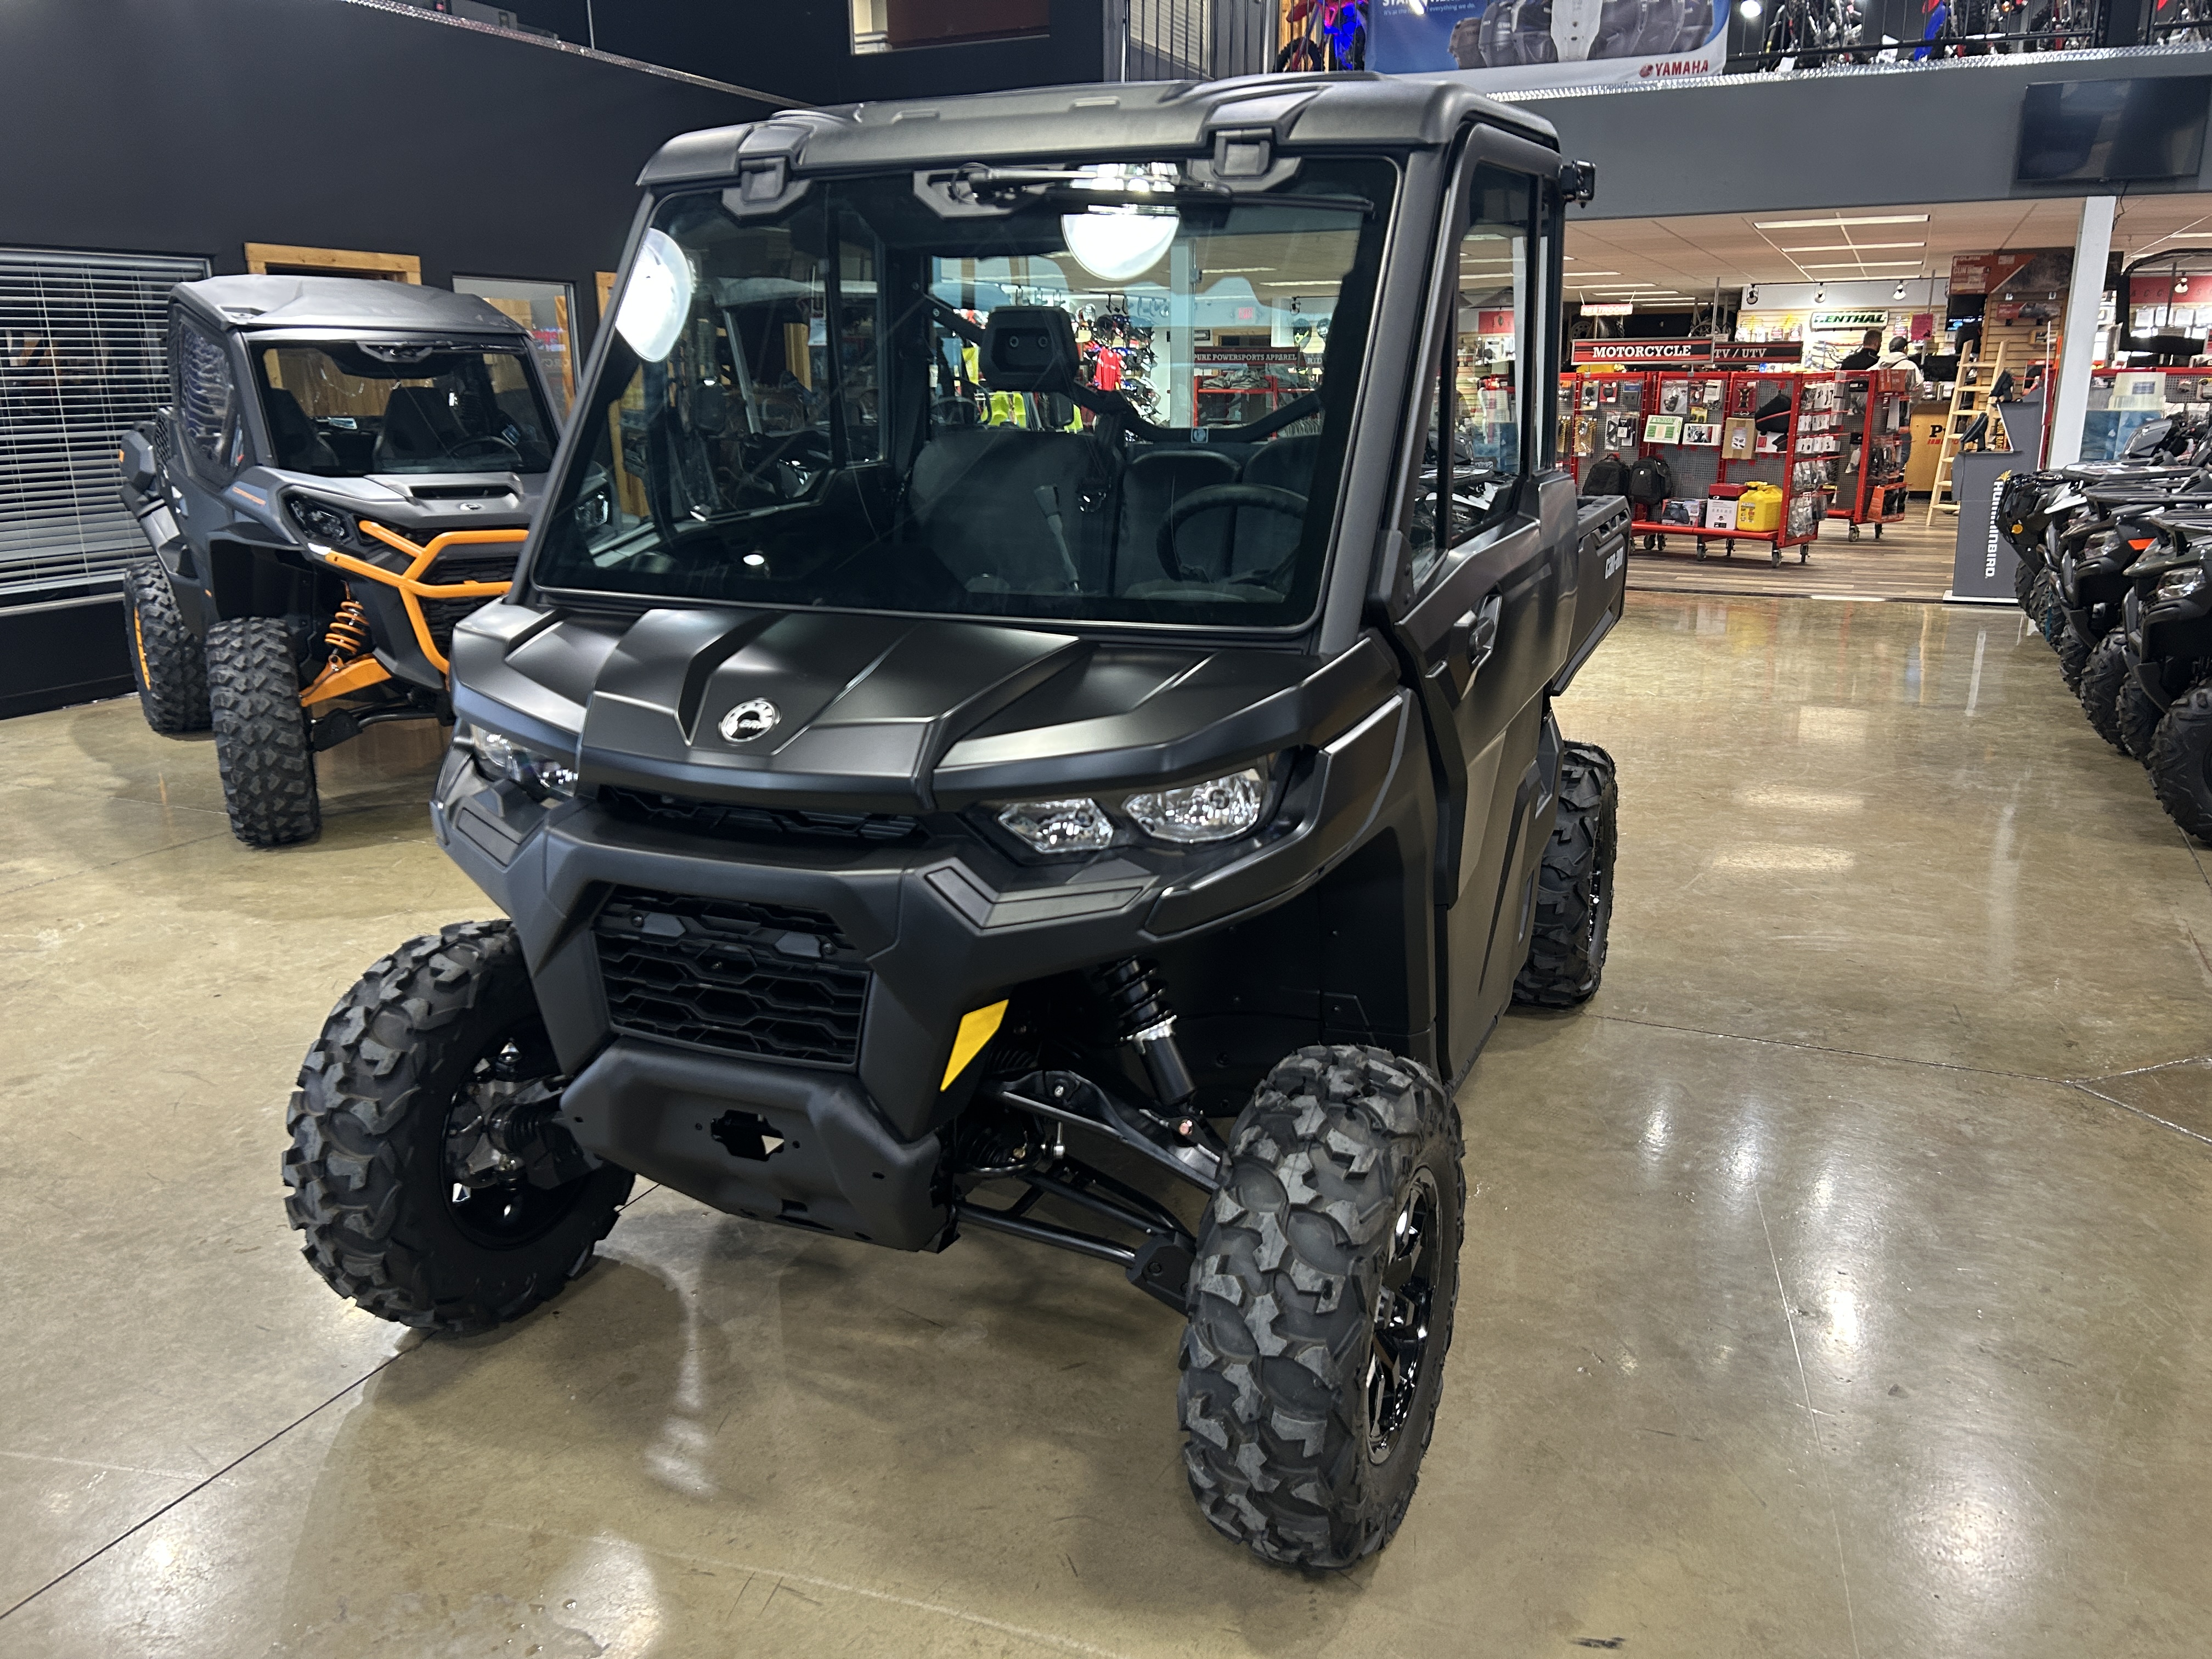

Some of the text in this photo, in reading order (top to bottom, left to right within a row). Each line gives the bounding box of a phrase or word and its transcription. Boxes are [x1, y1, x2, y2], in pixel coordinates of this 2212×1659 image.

[1655, 59, 1708, 77] YAMAHA
[1593, 345, 1691, 358] MOTORCYCLE
[1714, 348, 1731, 358] TV
[1742, 348, 1767, 358] UTV
